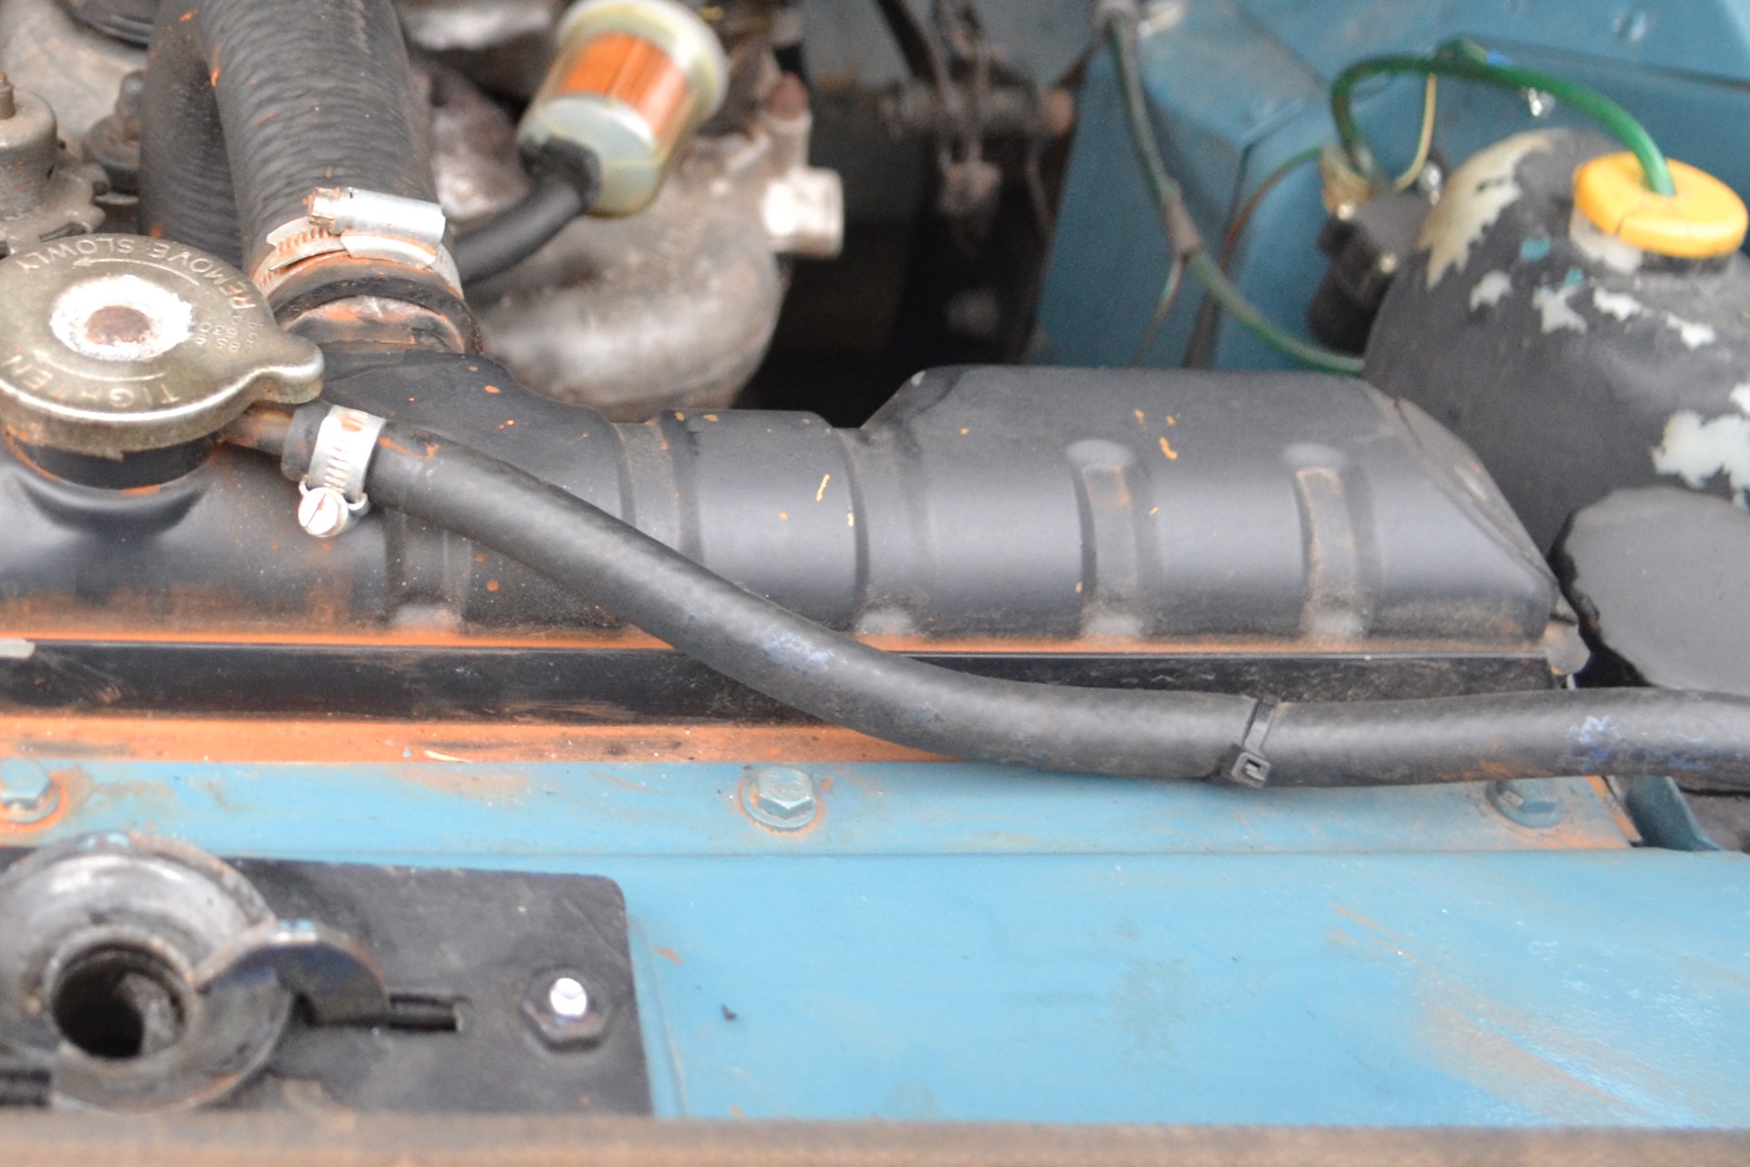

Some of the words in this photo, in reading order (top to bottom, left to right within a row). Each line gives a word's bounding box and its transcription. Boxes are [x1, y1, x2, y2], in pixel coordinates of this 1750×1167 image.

[14, 236, 136, 274] SLOWLY
[147, 242, 257, 310] REMOVE
[0, 352, 181, 408] TIGHTEN
